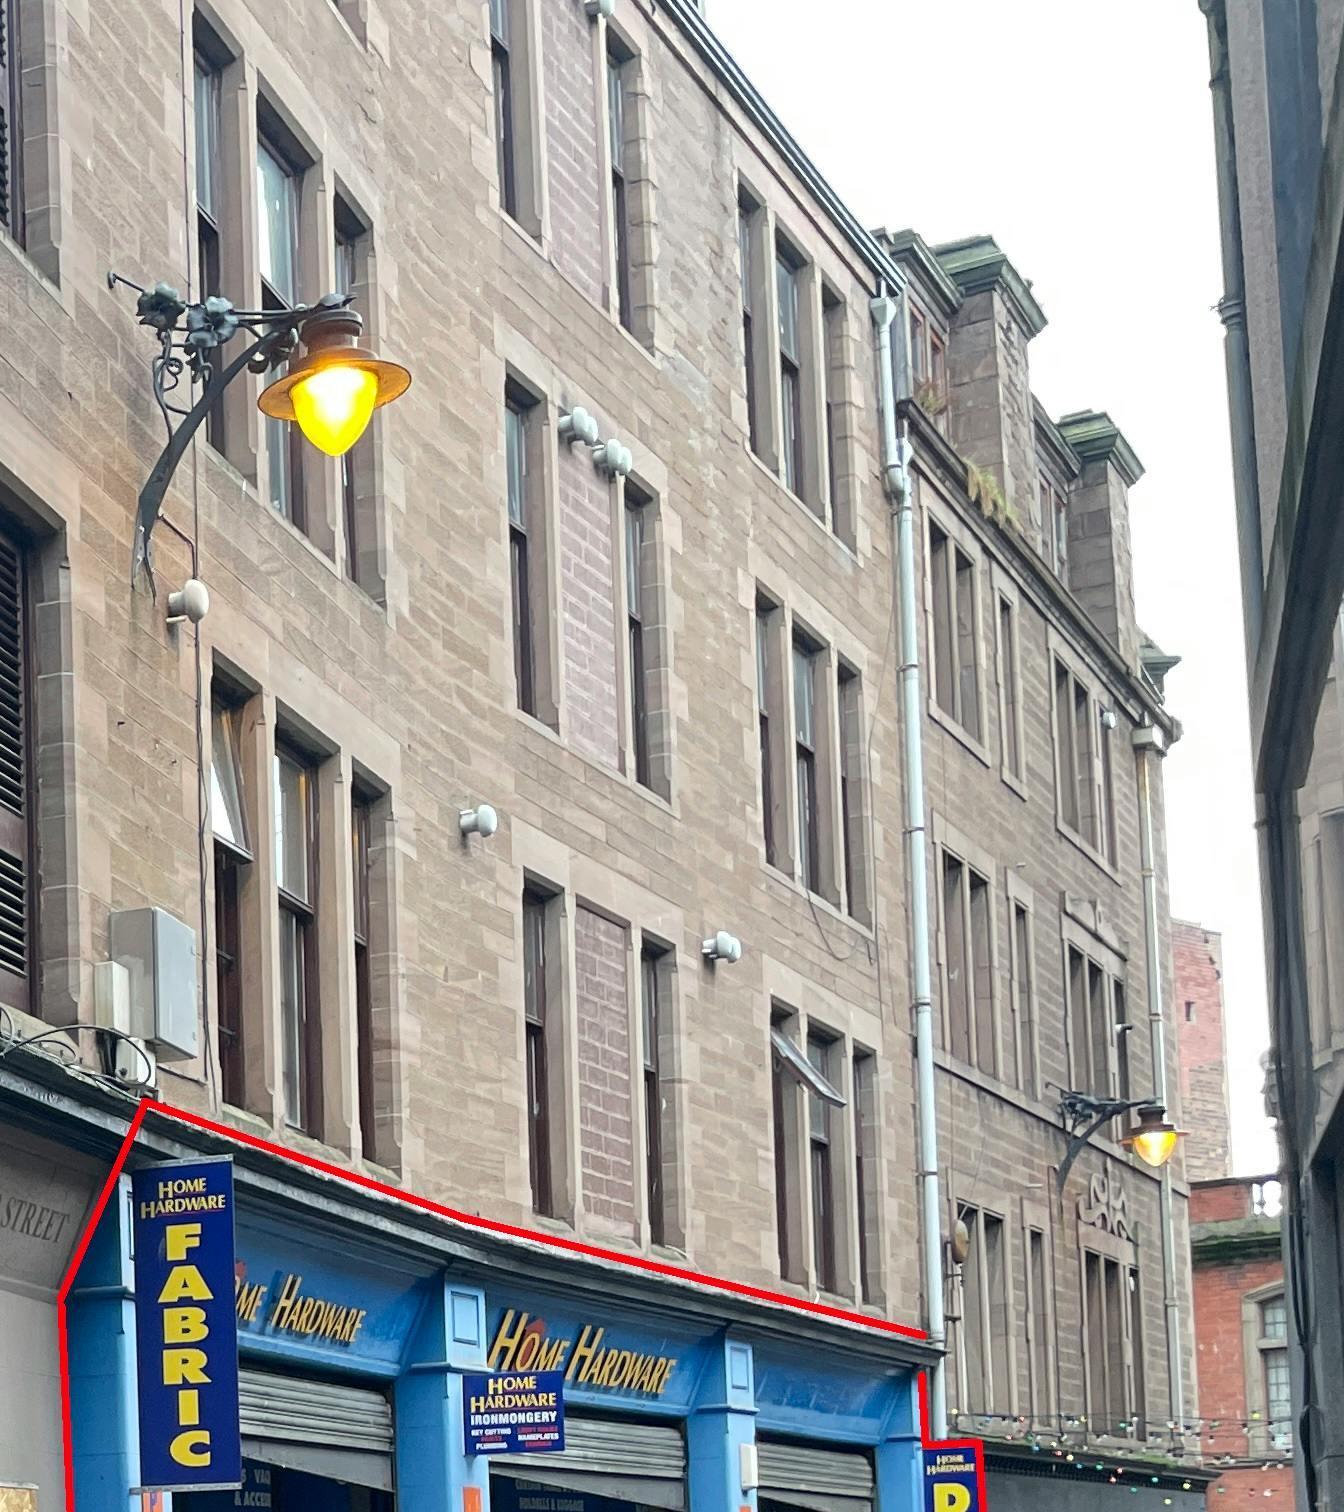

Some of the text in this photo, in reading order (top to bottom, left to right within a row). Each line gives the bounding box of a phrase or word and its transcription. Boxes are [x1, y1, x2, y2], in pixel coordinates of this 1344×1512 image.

[158, 1177, 207, 1199] HOME
[1, 1197, 70, 1243] STREET
[140, 1194, 226, 1220] HARDWARE
[270, 1273, 367, 1343] HARDWARE
[157, 1222, 214, 1468] FABRIC
[487, 1308, 679, 1394] HOME HARDWARE
[488, 1375, 537, 1395] HOME
[470, 1392, 557, 1413] HARDWARE
[470, 1411, 557, 1426] IRONMONGERY
